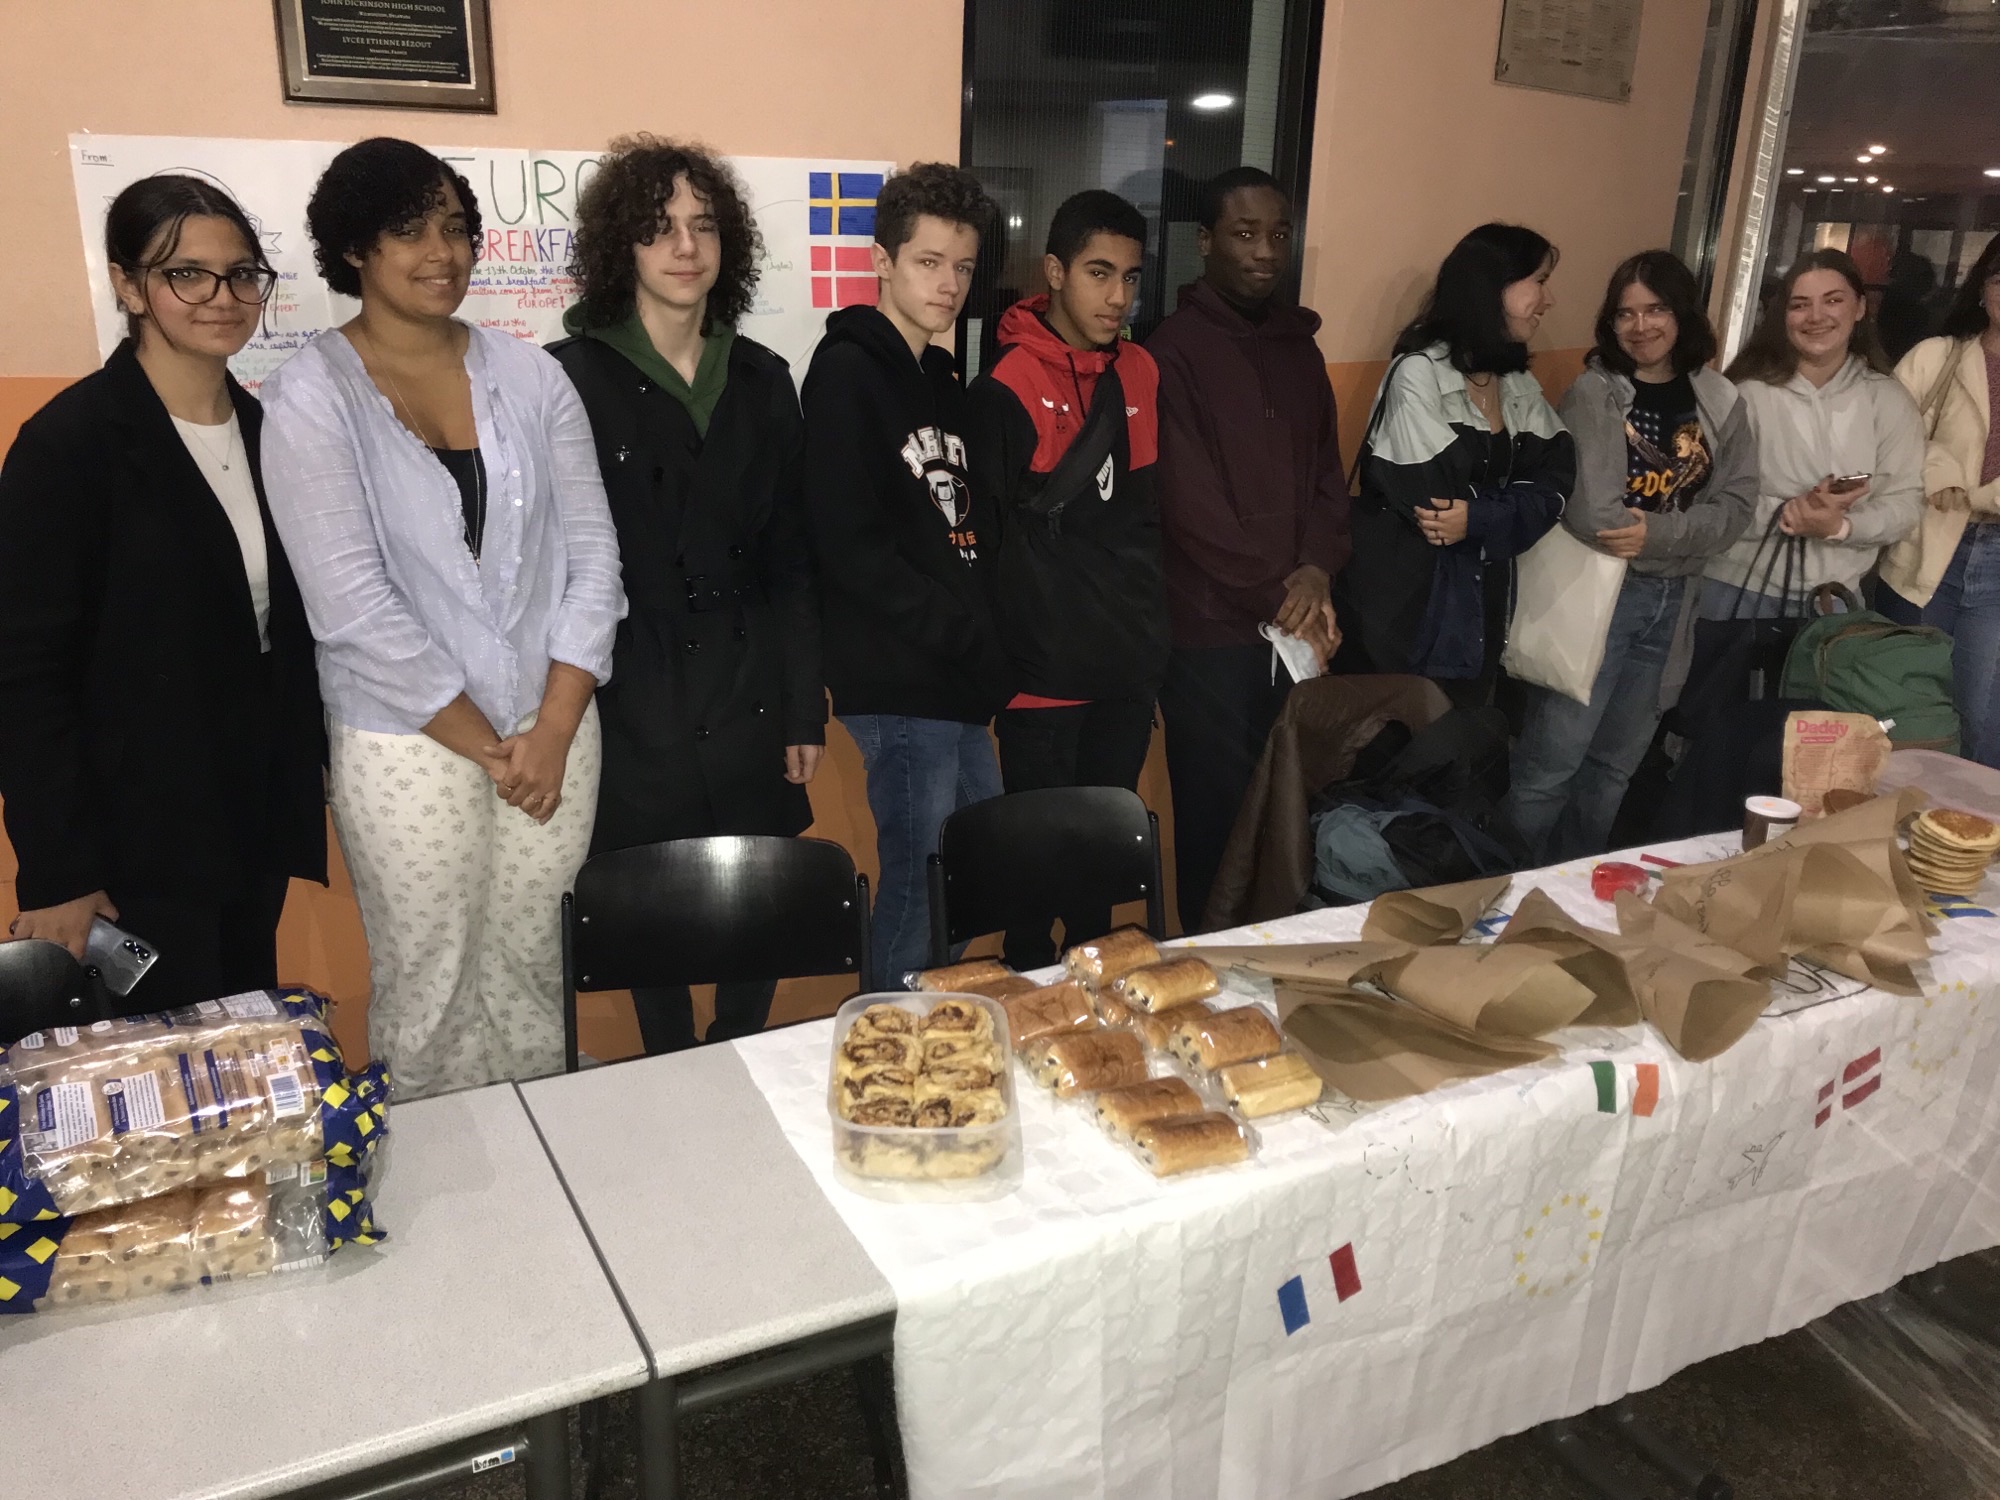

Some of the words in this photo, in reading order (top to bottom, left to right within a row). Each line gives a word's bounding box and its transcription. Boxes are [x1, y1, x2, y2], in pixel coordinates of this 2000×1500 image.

[344, 0, 391, 9] DICKINSON
[391, 3, 414, 11] HIGH
[414, 4, 446, 13] SCHOOL
[1796, 719, 1850, 738] Daddy
